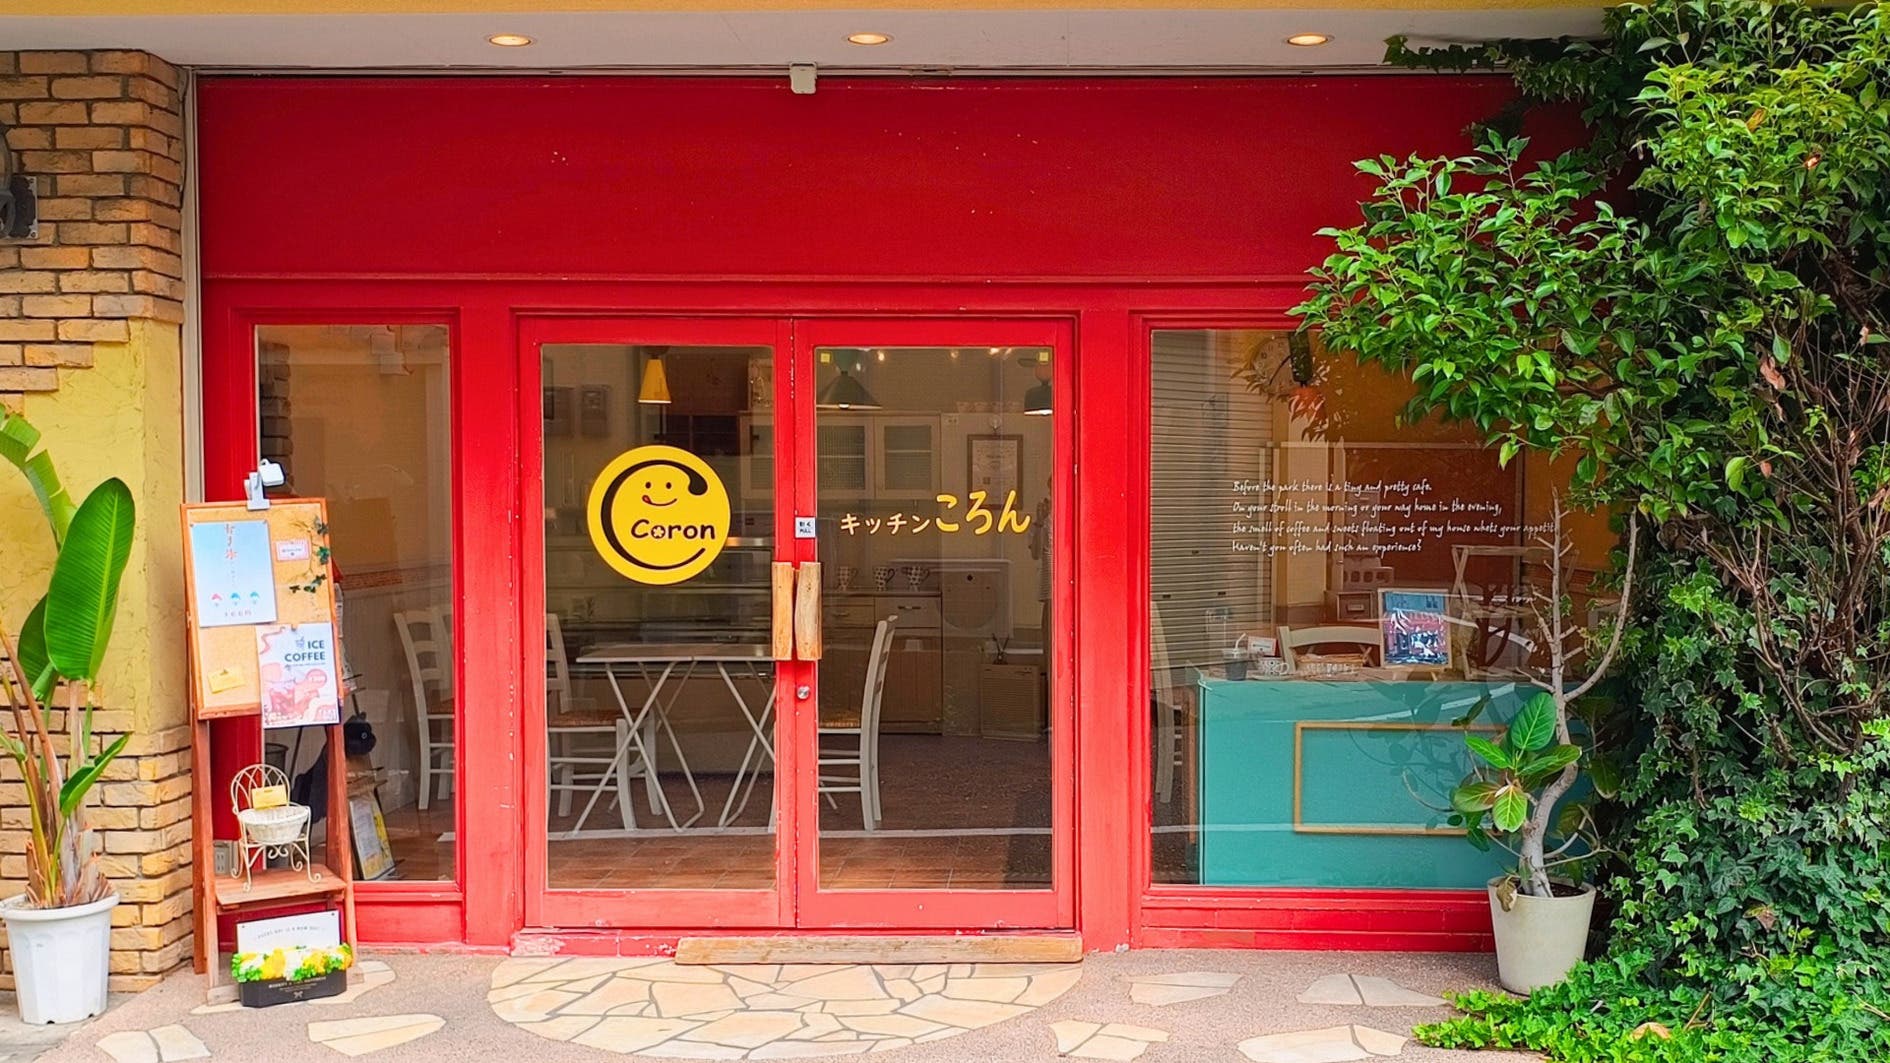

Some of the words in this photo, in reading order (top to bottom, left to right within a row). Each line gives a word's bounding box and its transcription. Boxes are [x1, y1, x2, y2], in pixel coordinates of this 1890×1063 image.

[1232, 479, 1259, 495] Before
[1263, 479, 1275, 492] the
[1278, 480, 1299, 499] park
[1302, 479, 1322, 491] there
[1344, 480, 1362, 497] tiny
[1365, 480, 1382, 491] and
[1384, 480, 1409, 498] pretty
[1412, 478, 1432, 495] cafe.
[1232, 501, 1245, 512] On
[1247, 504, 1267, 518] your
[1269, 499, 1291, 512] stroll
[1294, 501, 1303, 512] in
[1306, 498, 1319, 512] the
[1322, 502, 1357, 517] morning
[1370, 505, 1392, 518] your
[1394, 505, 1411, 518] way
[1414, 498, 1437, 512] home
[1439, 501, 1449, 512] in
[1451, 497, 1465, 512] the
[1467, 500, 1502, 517] evening,
[631, 519, 716, 540] Coron
[1232, 521, 1246, 533] the
[1248, 521, 1272, 532] smell
[1274, 521, 1285, 537] of
[1286, 521, 1310, 537] coffee
[1312, 522, 1330, 533] and
[1332, 522, 1358, 533] sweets
[1361, 520, 1396, 537] floating
[1398, 522, 1415, 533] out
[1417, 520, 1428, 537] of
[1429, 525, 1444, 538] my
[1446, 520, 1471, 533] house
[1499, 525, 1521, 538] your
[1523, 522, 1556, 540] appetit
[1232, 539, 1267, 553] Haven't
[1268, 545, 1286, 557] you
[1289, 540, 1312, 555] often
[1315, 540, 1332, 551] had
[1334, 539, 1353, 551] such
[1372, 538, 1422, 559] experience?
[307, 640, 325, 649] ICE
[284, 651, 326, 662] COFFEE
